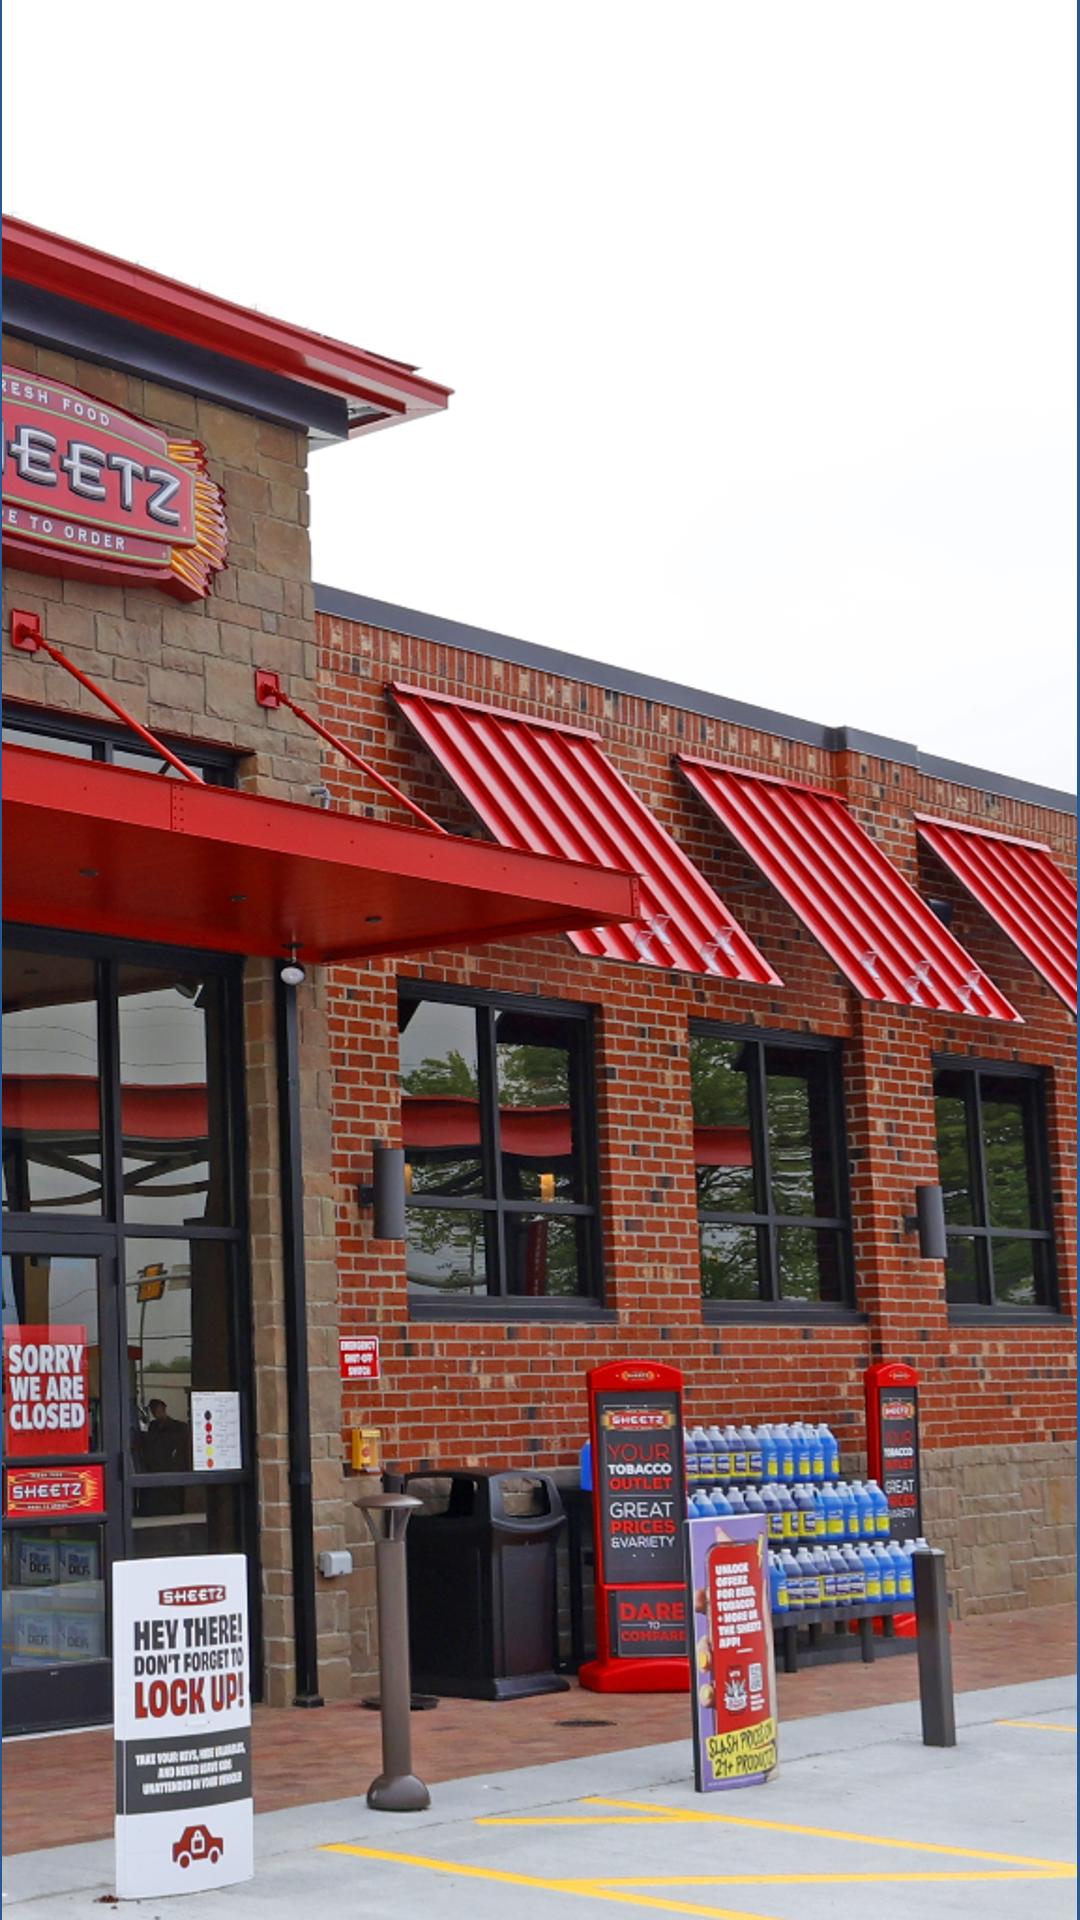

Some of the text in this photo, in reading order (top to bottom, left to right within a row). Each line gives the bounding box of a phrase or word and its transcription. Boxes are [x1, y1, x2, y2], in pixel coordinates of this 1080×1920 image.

[63, 399, 110, 426] FOOD
[30, 515, 53, 533] TO
[65, 526, 125, 550] ORDER
[8, 1344, 84, 1374] SORRY
[10, 1376, 84, 1401] WE ARE
[10, 1402, 85, 1430] CLOSED
[612, 1415, 664, 1425] SHEETZ
[607, 1443, 670, 1461] YOUR
[607, 1464, 672, 1475] TOBACCO
[13, 1483, 81, 1499] SHEETZ
[610, 1476, 672, 1490] OUTLET
[885, 1479, 914, 1494] GREAT
[610, 1501, 674, 1518] GREAT
[610, 1519, 676, 1534] PRICES
[163, 1588, 224, 1604] SHEETZ
[619, 1602, 685, 1620] DARE
[134, 1613, 242, 1651] HEY THERE!
[647, 1621, 660, 1630] TO
[134, 1647, 244, 1676] DON'T FORGET TO
[135, 1672, 244, 1718] LOCK UP!
[709, 1734, 739, 1759] SLASH
[157, 1751, 179, 1765] YOUR
[157, 1766, 175, 1779] AND
